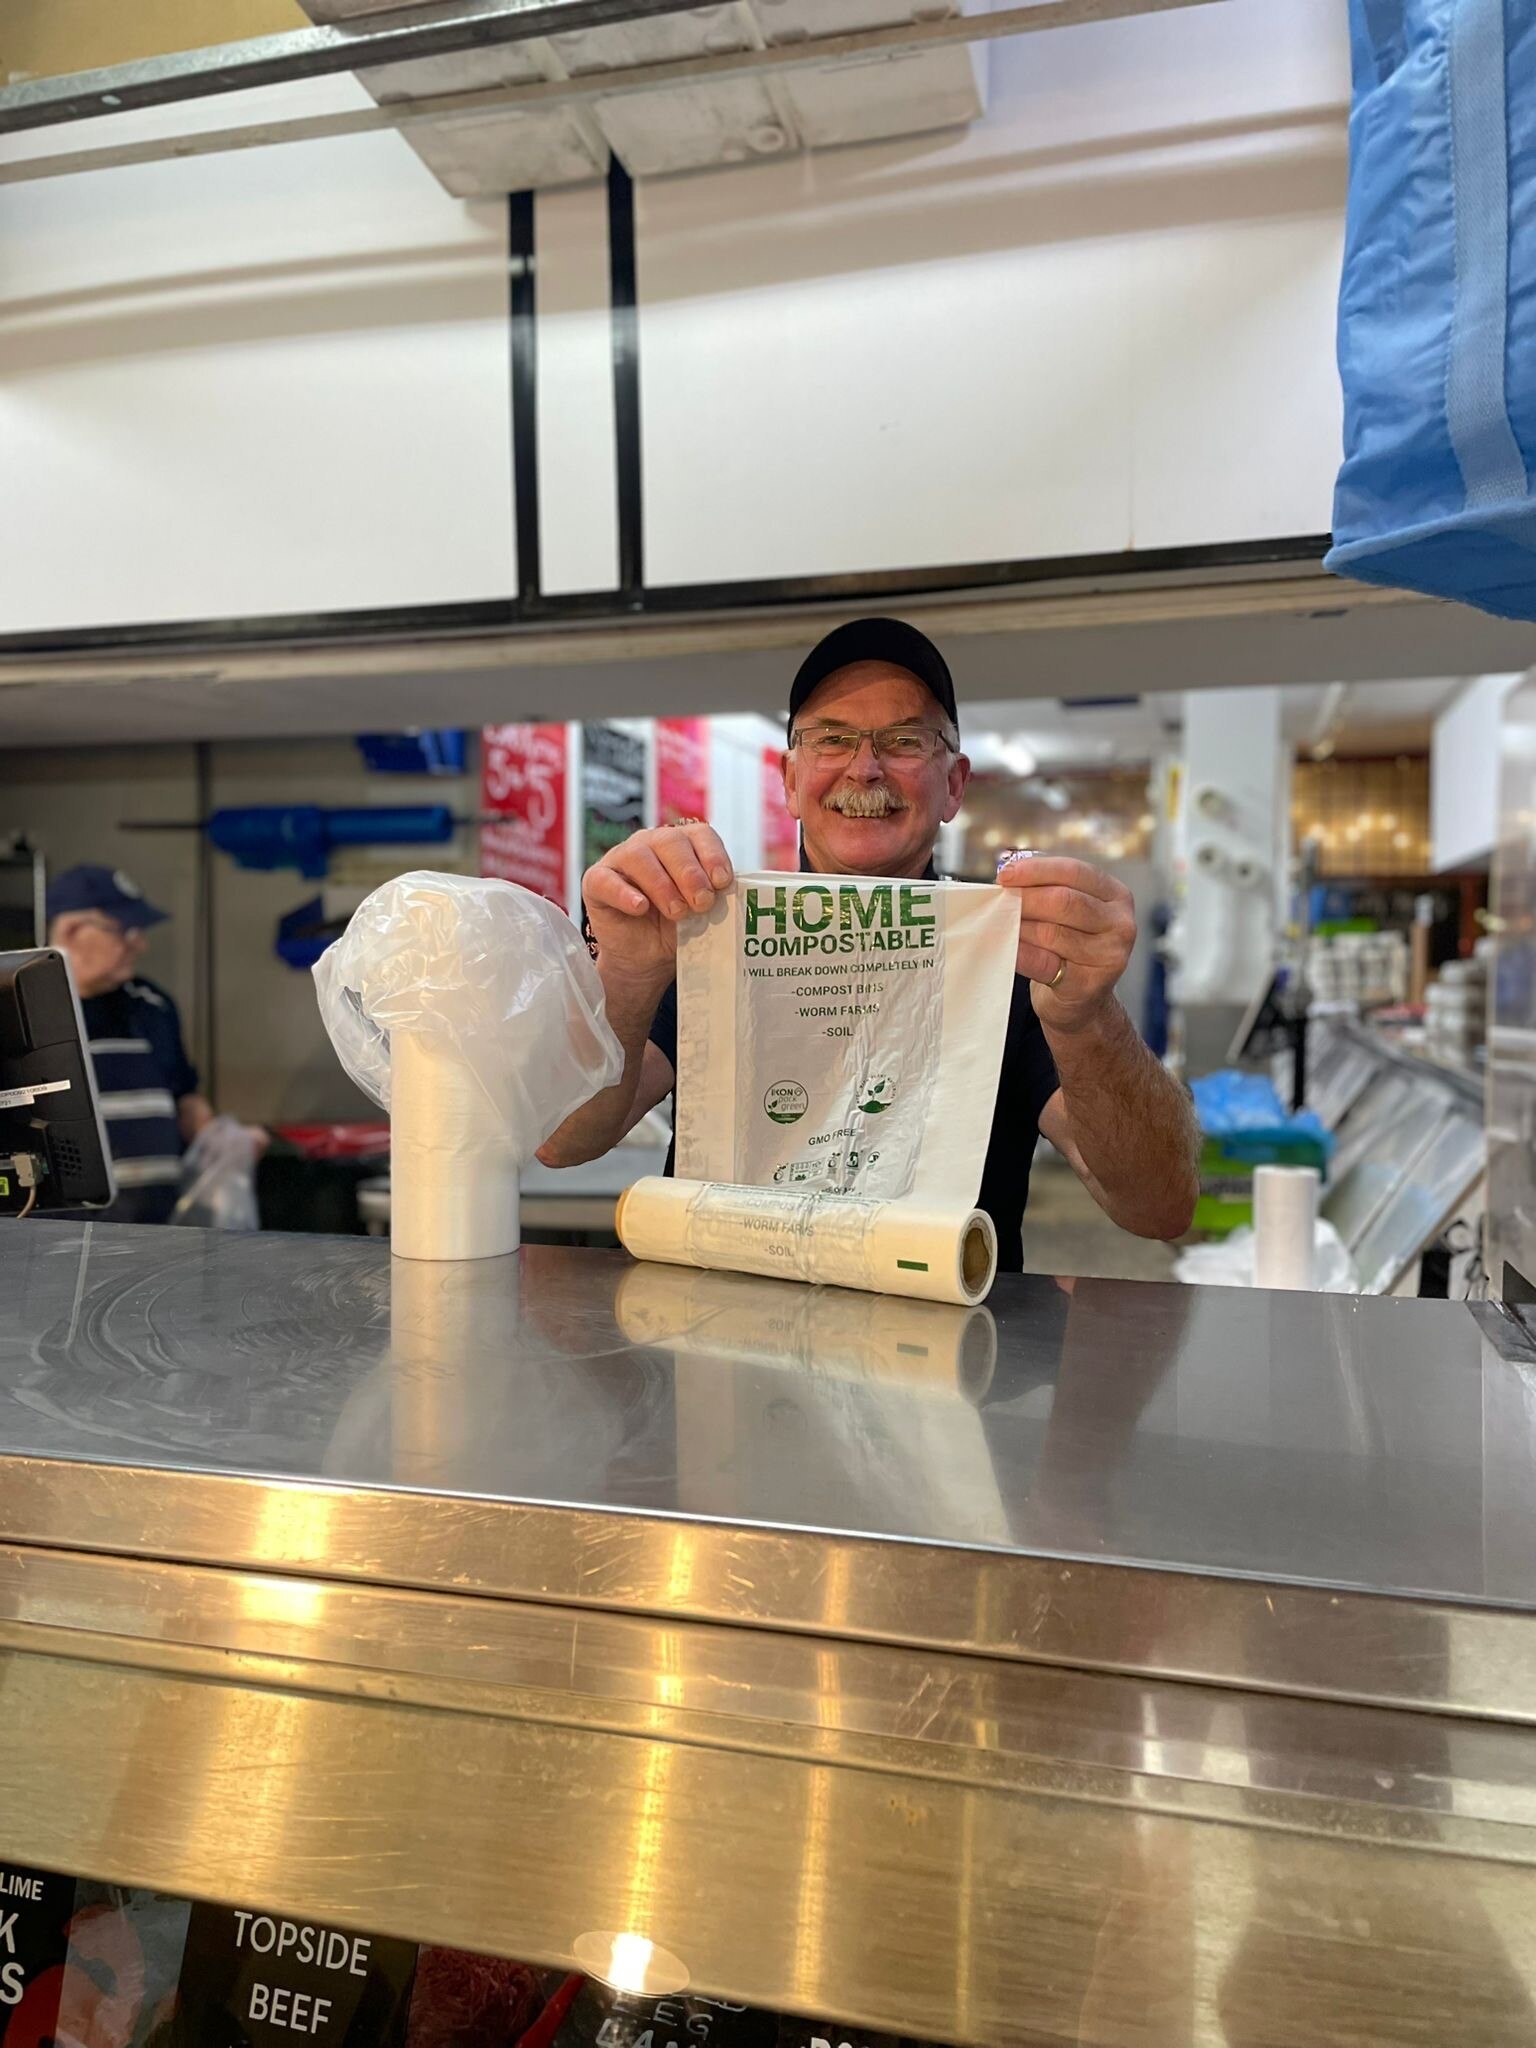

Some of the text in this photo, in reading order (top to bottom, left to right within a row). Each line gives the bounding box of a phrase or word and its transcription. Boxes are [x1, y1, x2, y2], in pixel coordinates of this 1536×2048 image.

[744, 884, 936, 935] HOME
[744, 928, 935, 958] COMPOSTABLE
[748, 968, 774, 977] WILL
[776, 966, 812, 977] BREAK
[814, 964, 848, 975] DOWN
[850, 960, 919, 974] COMPLETELY
[922, 959, 934, 969] IN
[840, 1003, 880, 1016] FARMS
[808, 1128, 857, 1146] GMO FREE
[0, 1872, 44, 1901] LIME
[233, 1911, 372, 1977] TOPSIDE
[248, 1983, 333, 2035] BEEF
